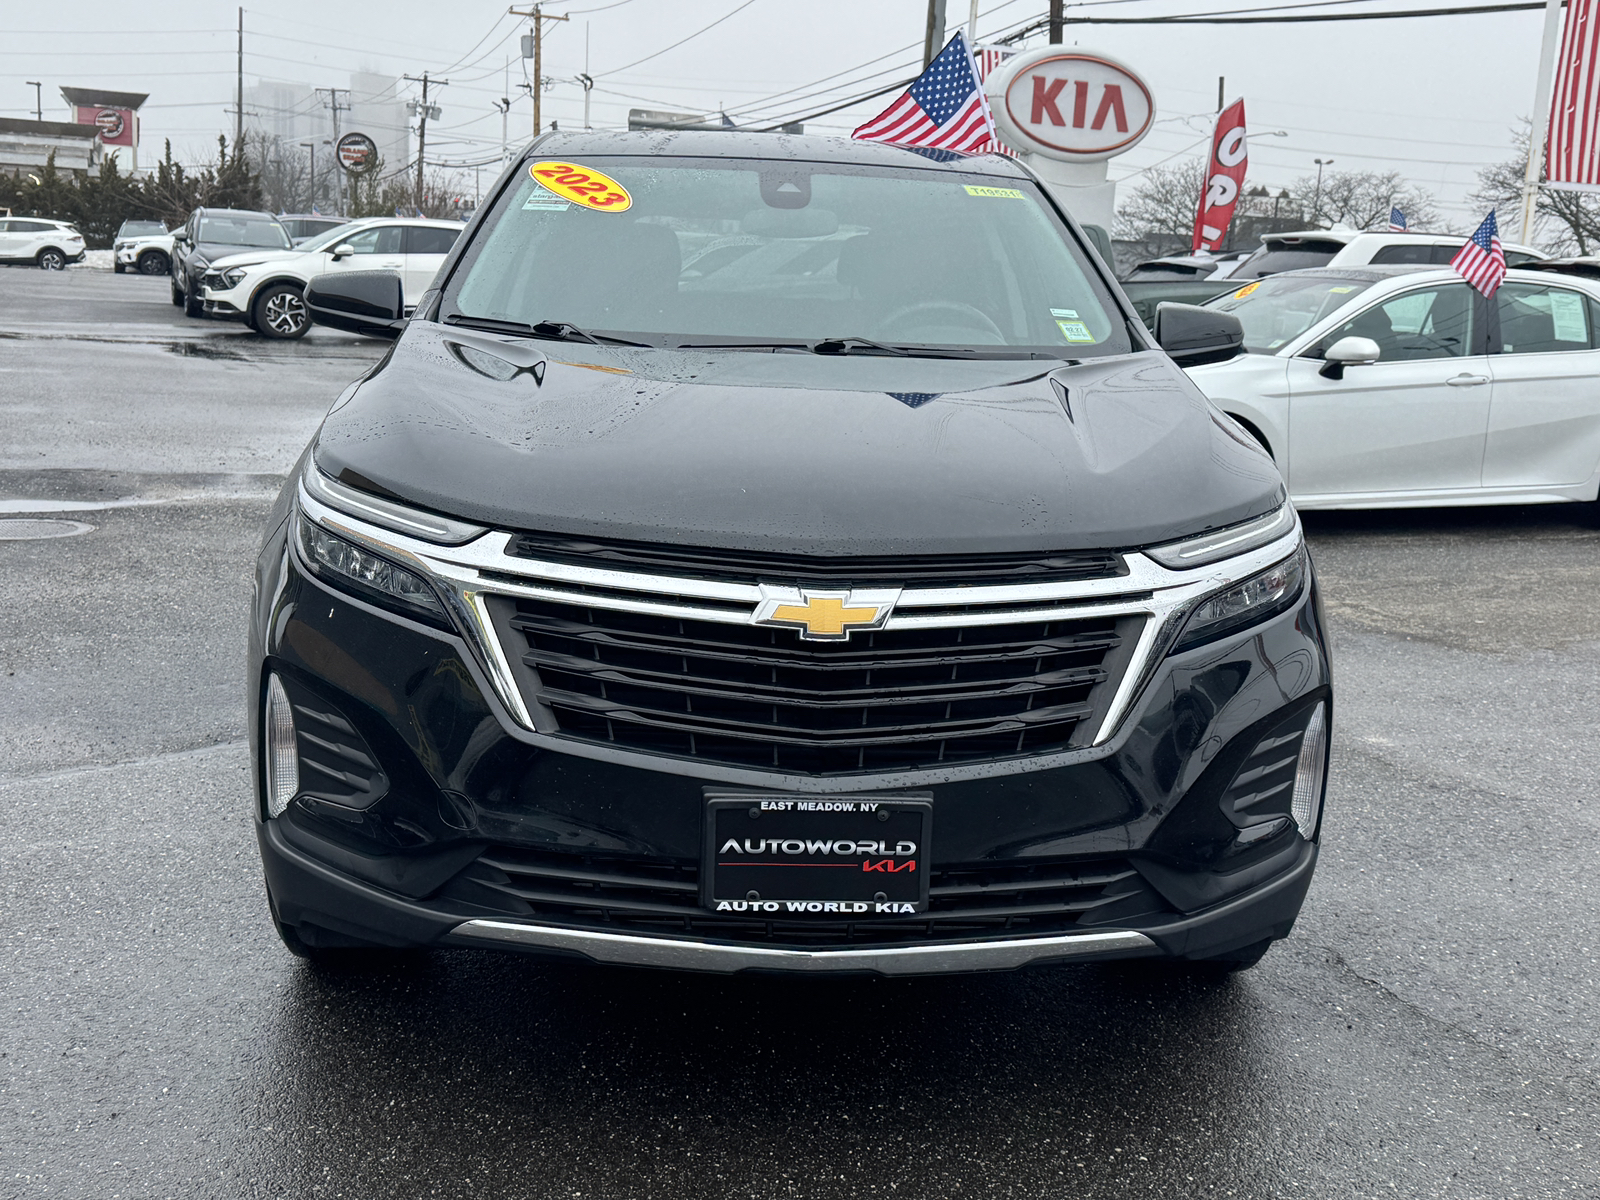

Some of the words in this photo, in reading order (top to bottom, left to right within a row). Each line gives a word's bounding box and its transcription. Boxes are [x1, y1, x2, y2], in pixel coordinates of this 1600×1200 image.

[1030, 75, 1128, 133] KIA
[534, 165, 626, 206] 2023
[760, 801, 794, 811] EAST
[860, 803, 879, 812] NY
[719, 838, 917, 856] AUTOWORLD
[862, 859, 916, 873] KIA
[716, 901, 780, 911] AUTO
[786, 902, 868, 913] WORLD
[875, 902, 916, 914] KIA
